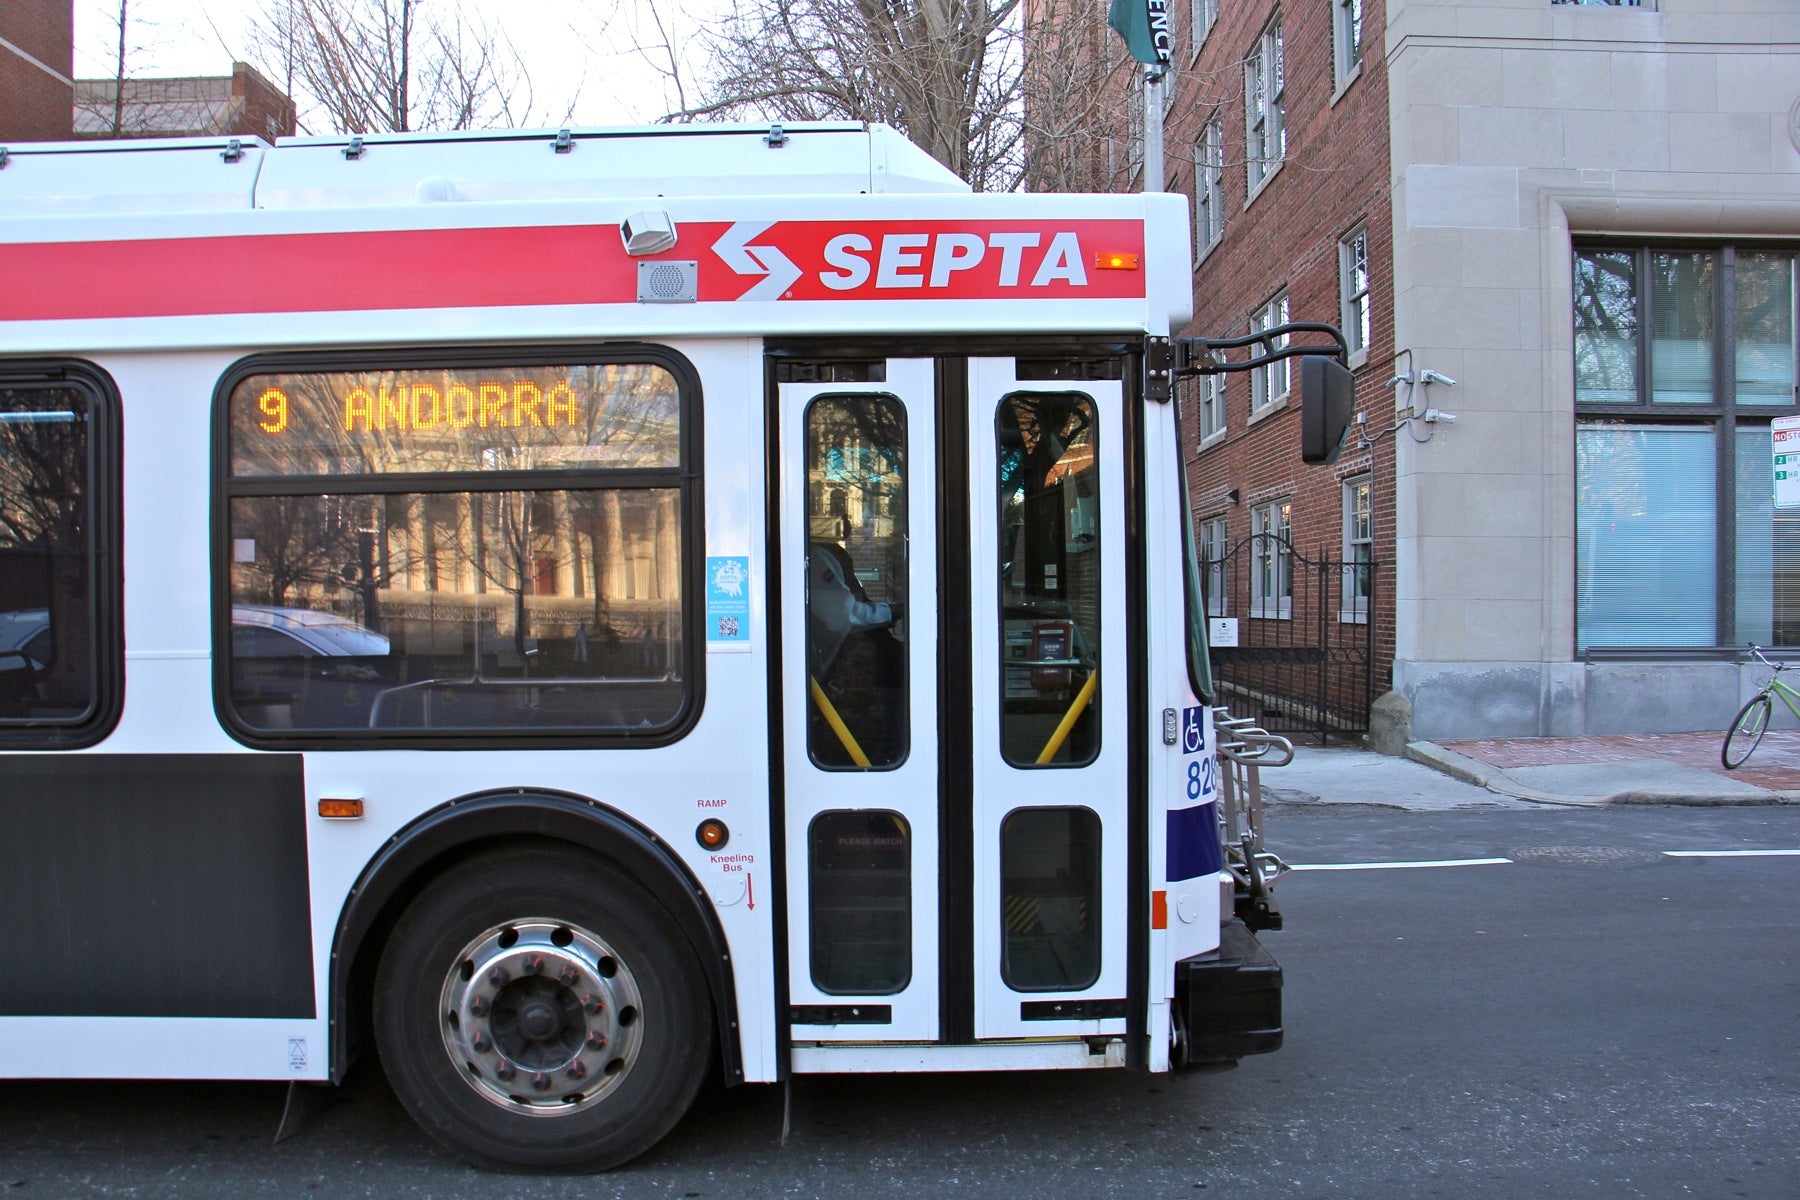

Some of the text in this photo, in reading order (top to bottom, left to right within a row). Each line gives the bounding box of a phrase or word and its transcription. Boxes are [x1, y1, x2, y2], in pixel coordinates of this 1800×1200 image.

[819, 232, 1089, 291] SEPTA
[259, 380, 577, 433] 9 ANDORRA
[1774, 432, 1786, 442] NO
[1788, 455, 1798, 463] HR
[1788, 470, 1798, 478] HR
[697, 799, 727, 807] RAMP
[710, 854, 754, 863] Kneeling
[723, 863, 743, 872] Bus
